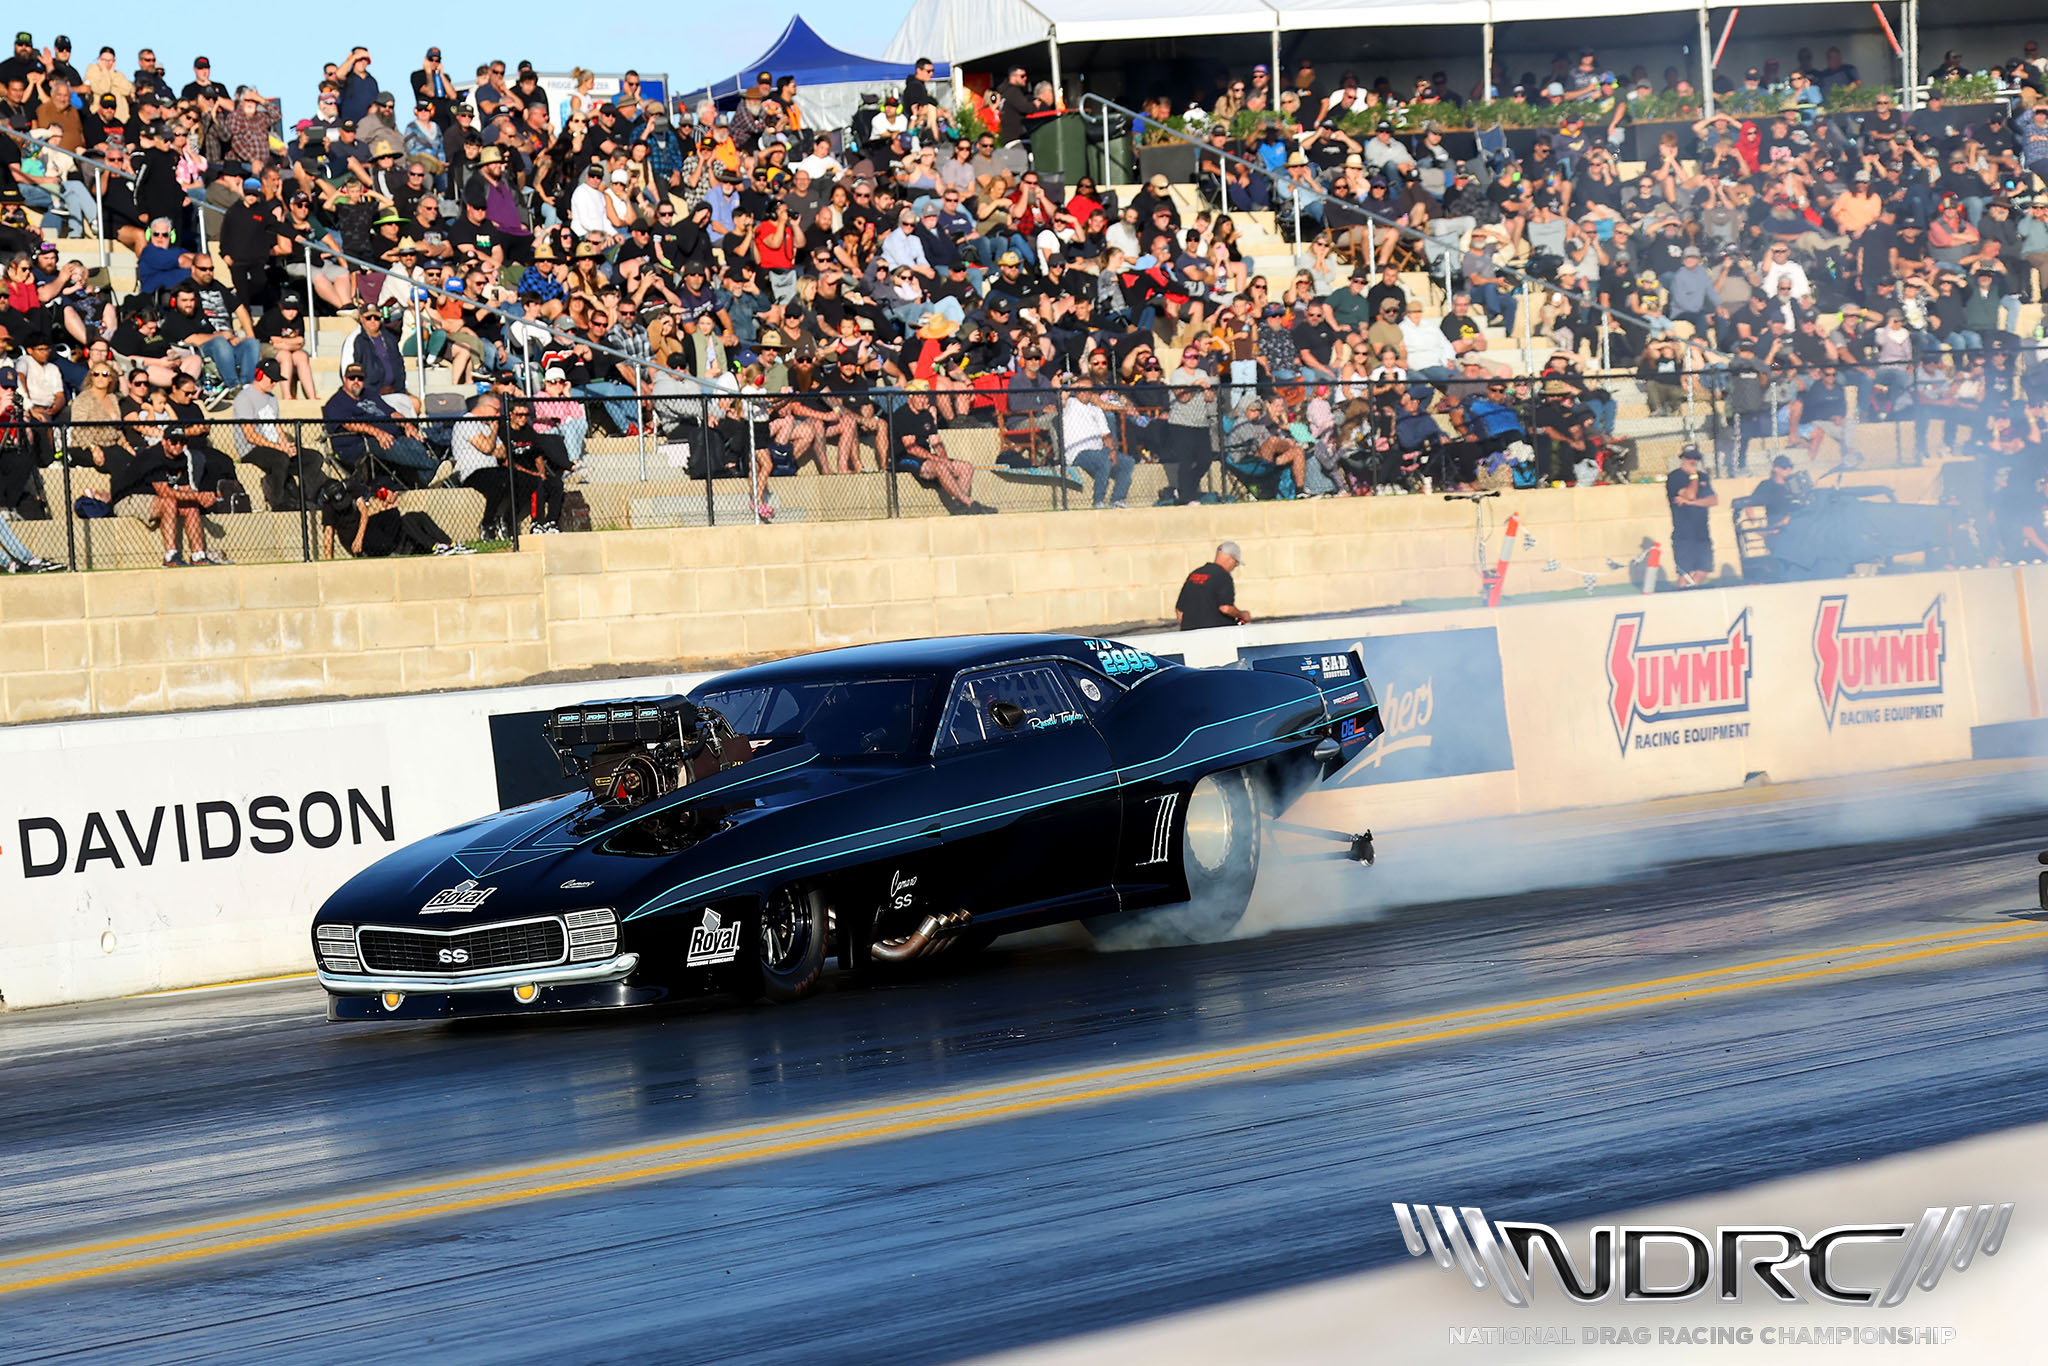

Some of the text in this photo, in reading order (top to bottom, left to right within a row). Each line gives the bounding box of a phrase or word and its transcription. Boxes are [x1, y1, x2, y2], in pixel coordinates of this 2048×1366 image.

[1097, 647, 1158, 676] 2995
[1840, 704, 1944, 726] RACING EQUIPMENT
[1635, 722, 1751, 750] RACING EQUIPMENT
[18, 785, 395, 878] DAVIDSON
[894, 893, 912, 909] SS
[690, 921, 740, 954] Royal
[438, 949, 470, 963] SS
